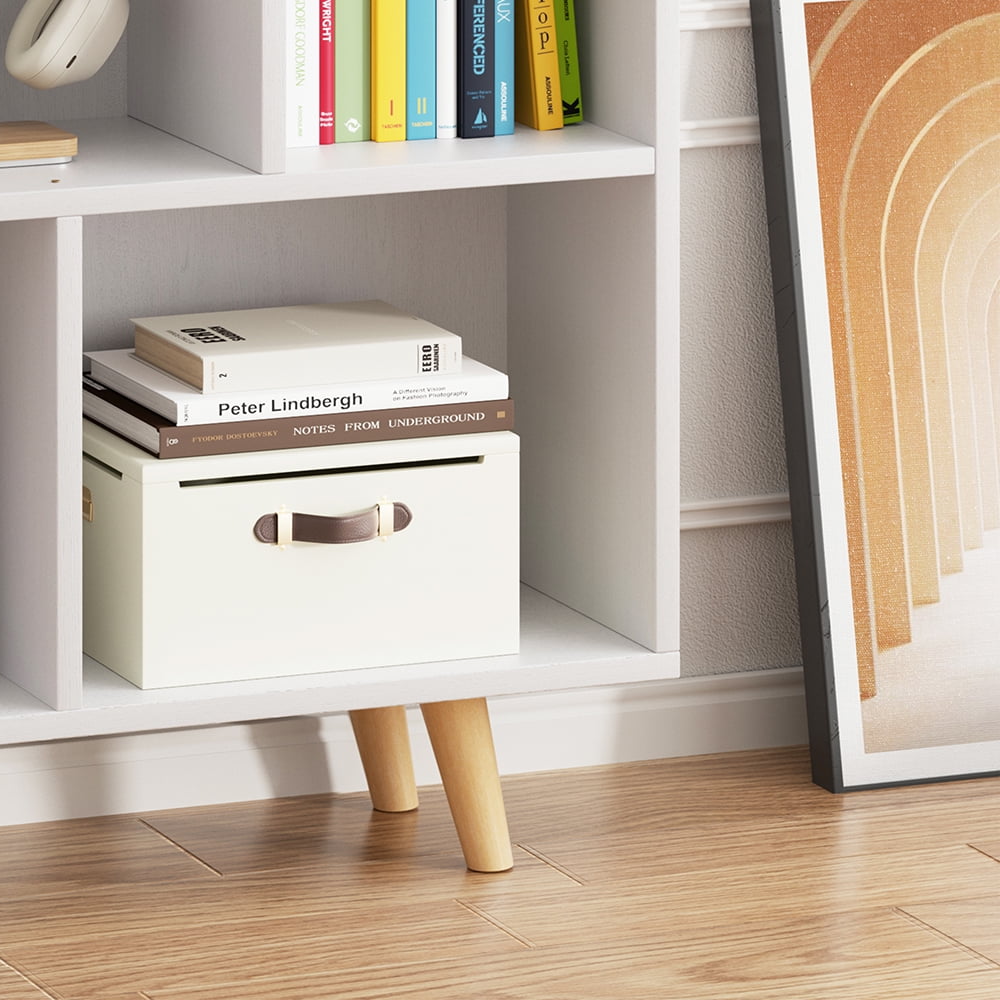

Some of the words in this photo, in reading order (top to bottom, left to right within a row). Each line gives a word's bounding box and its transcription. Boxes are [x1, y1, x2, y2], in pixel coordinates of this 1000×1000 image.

[322, 0, 332, 42] WRIGHT
[295, 32, 305, 87] GOODMAN
[500, 81, 508, 122] ASSOULINE
[545, 76, 554, 115] ASSOULINE
[422, 345, 432, 372] EERO
[218, 402, 265, 417] Peter
[271, 393, 363, 411] Lindbergh
[402, 393, 427, 401] Fashion
[293, 424, 336, 436] NOTES
[344, 420, 380, 432] FROM
[388, 411, 486, 428] UNDERGROUND
[192, 435, 224, 443] FYODOR
